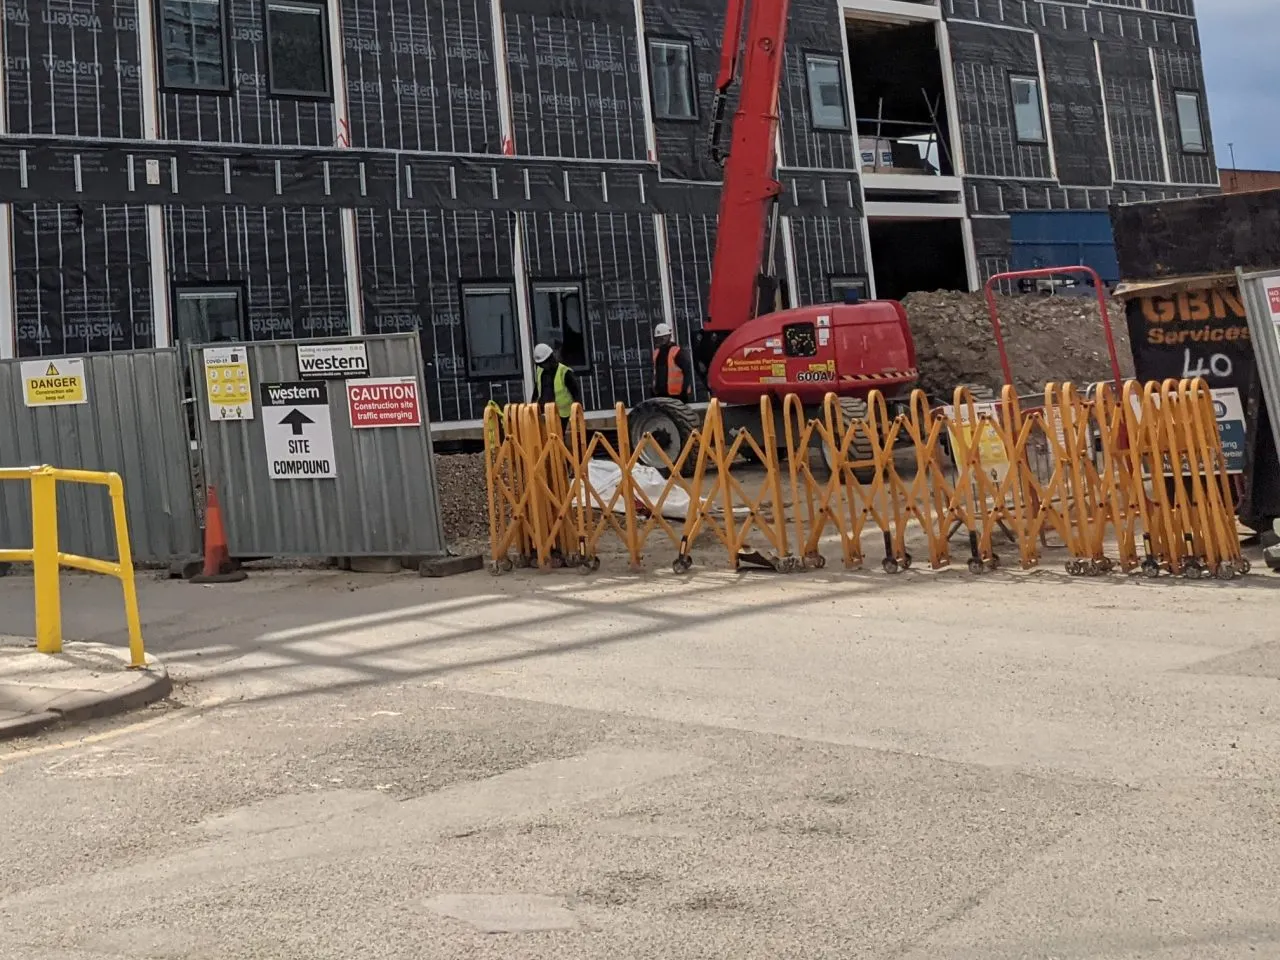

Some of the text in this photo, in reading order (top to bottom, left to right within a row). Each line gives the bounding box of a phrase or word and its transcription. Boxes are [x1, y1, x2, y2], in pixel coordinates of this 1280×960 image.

[1147, 325, 1250, 345] Services
[301, 355, 365, 370] western
[1182, 348, 1233, 377] 40
[30, 377, 77, 389] DANGER
[268, 386, 320, 399] western
[351, 386, 414, 401] CAUTION
[354, 400, 414, 410] Construction site
[357, 411, 413, 420] traffic emerging
[288, 440, 310, 454] SITE
[273, 460, 330, 475] COMPOUND
